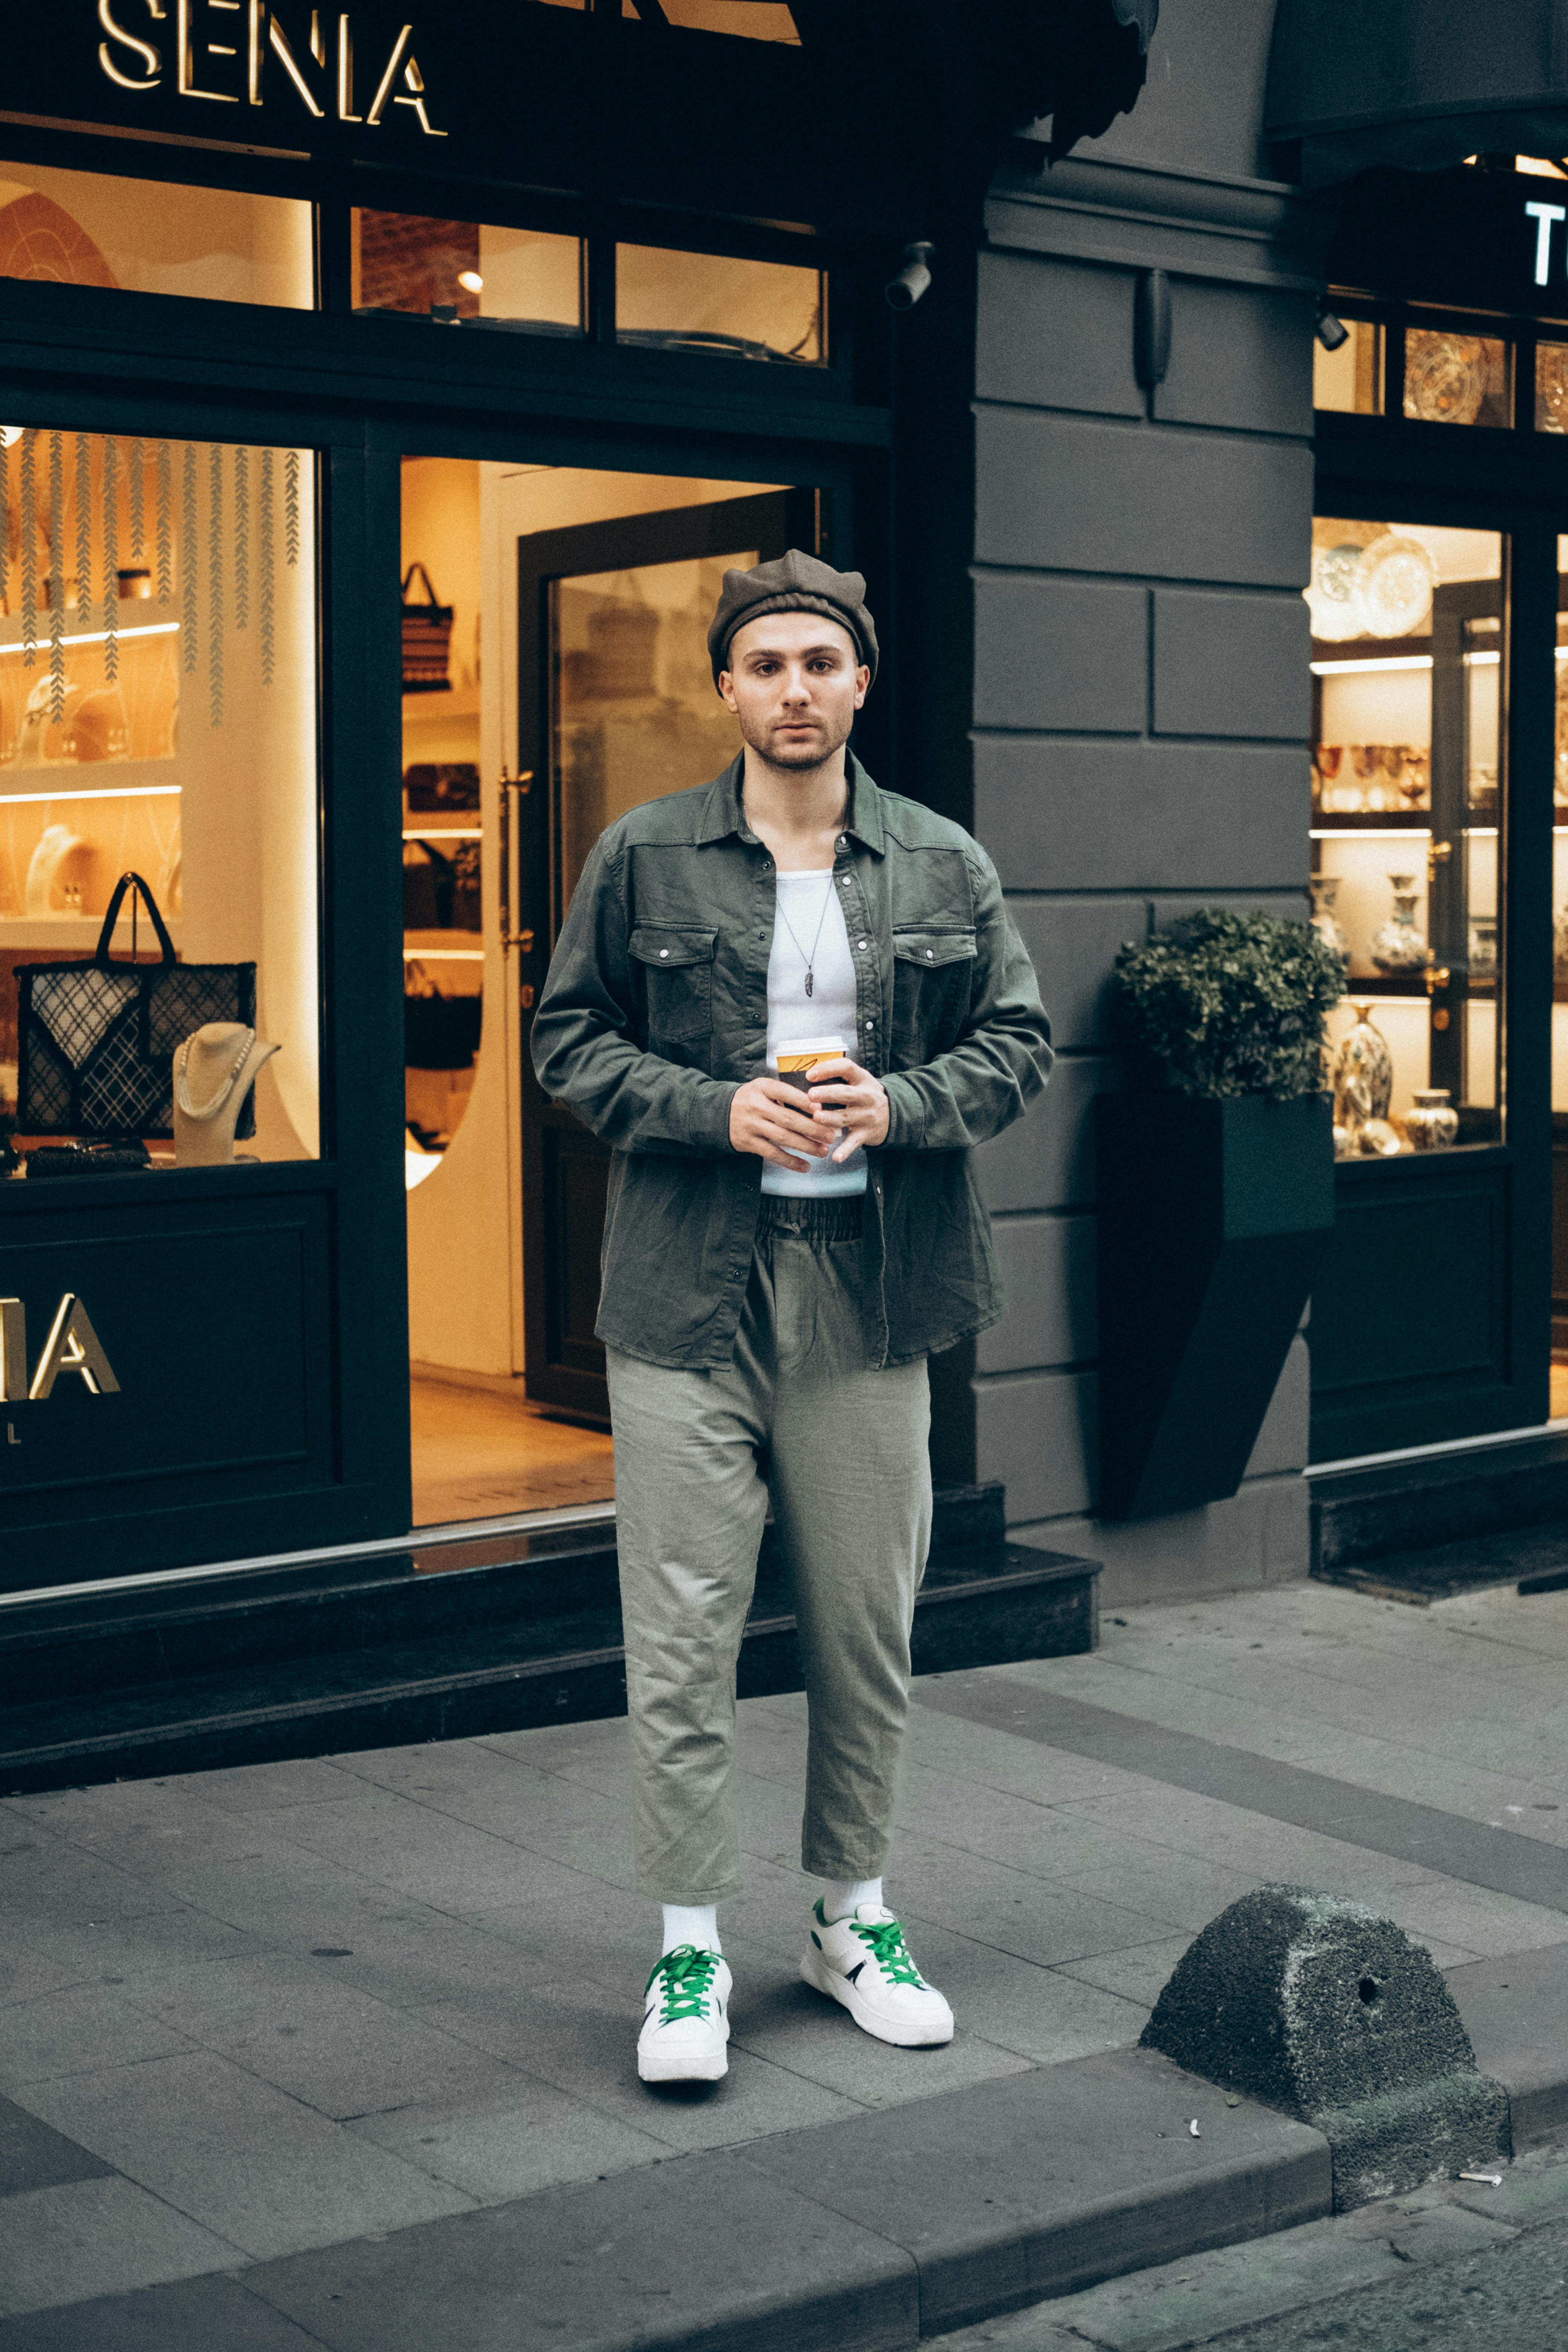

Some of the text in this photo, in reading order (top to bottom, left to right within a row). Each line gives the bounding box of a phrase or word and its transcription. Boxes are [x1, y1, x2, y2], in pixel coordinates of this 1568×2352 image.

[98, 0, 449, 136] SENIA
[1525, 201, 1568, 286] T
[8, 1422, 21, 1444] L
